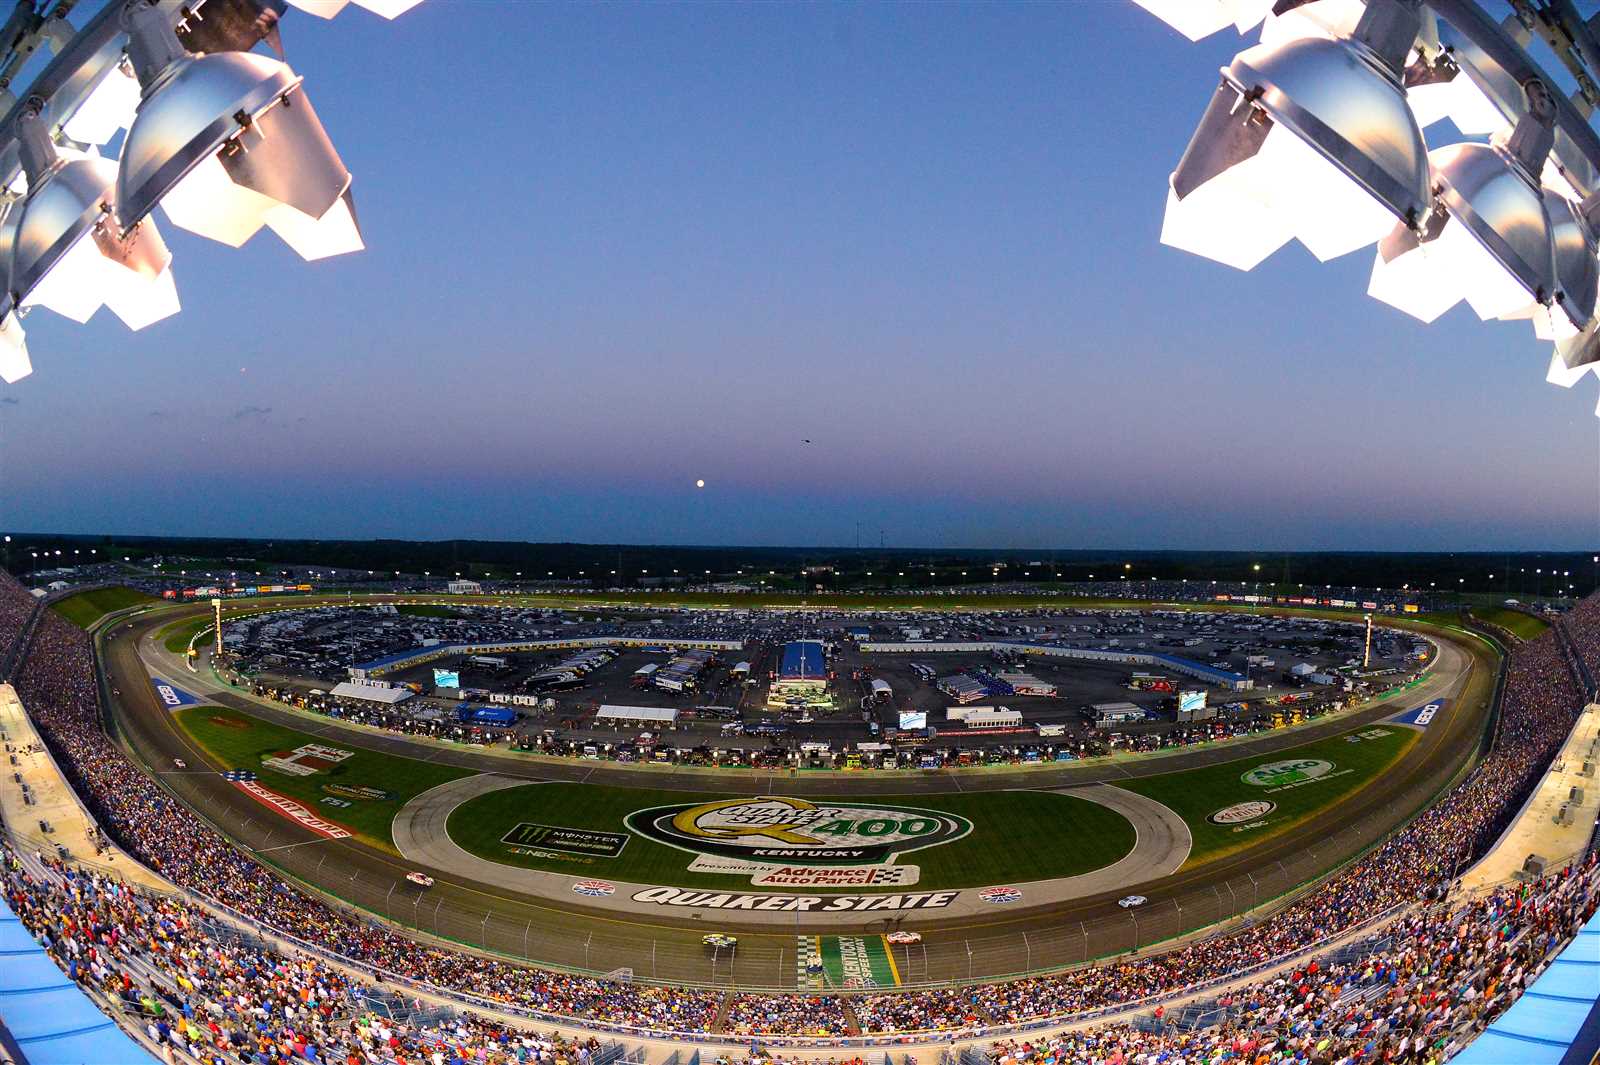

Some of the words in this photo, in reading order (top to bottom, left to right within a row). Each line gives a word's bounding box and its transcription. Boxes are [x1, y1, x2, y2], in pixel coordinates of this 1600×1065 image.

[242, 780, 305, 815] RESTART
[299, 815, 349, 837] ZONE
[717, 806, 840, 817] QUAKER
[727, 815, 819, 825] STATE
[811, 818, 940, 836] 400
[552, 831, 620, 844] MONSTER
[526, 849, 559, 859] NBC
[752, 849, 864, 857] KENTUCKY
[695, 863, 758, 871] Presented
[759, 864, 775, 872] by
[773, 867, 867, 876] Advance
[760, 875, 811, 884] Auto
[812, 876, 865, 884] Parts
[631, 887, 822, 911] QUAKER
[822, 891, 960, 911] STATE
[838, 936, 862, 977] KENTUCKY
[854, 937, 873, 978] SPEEDWAY
